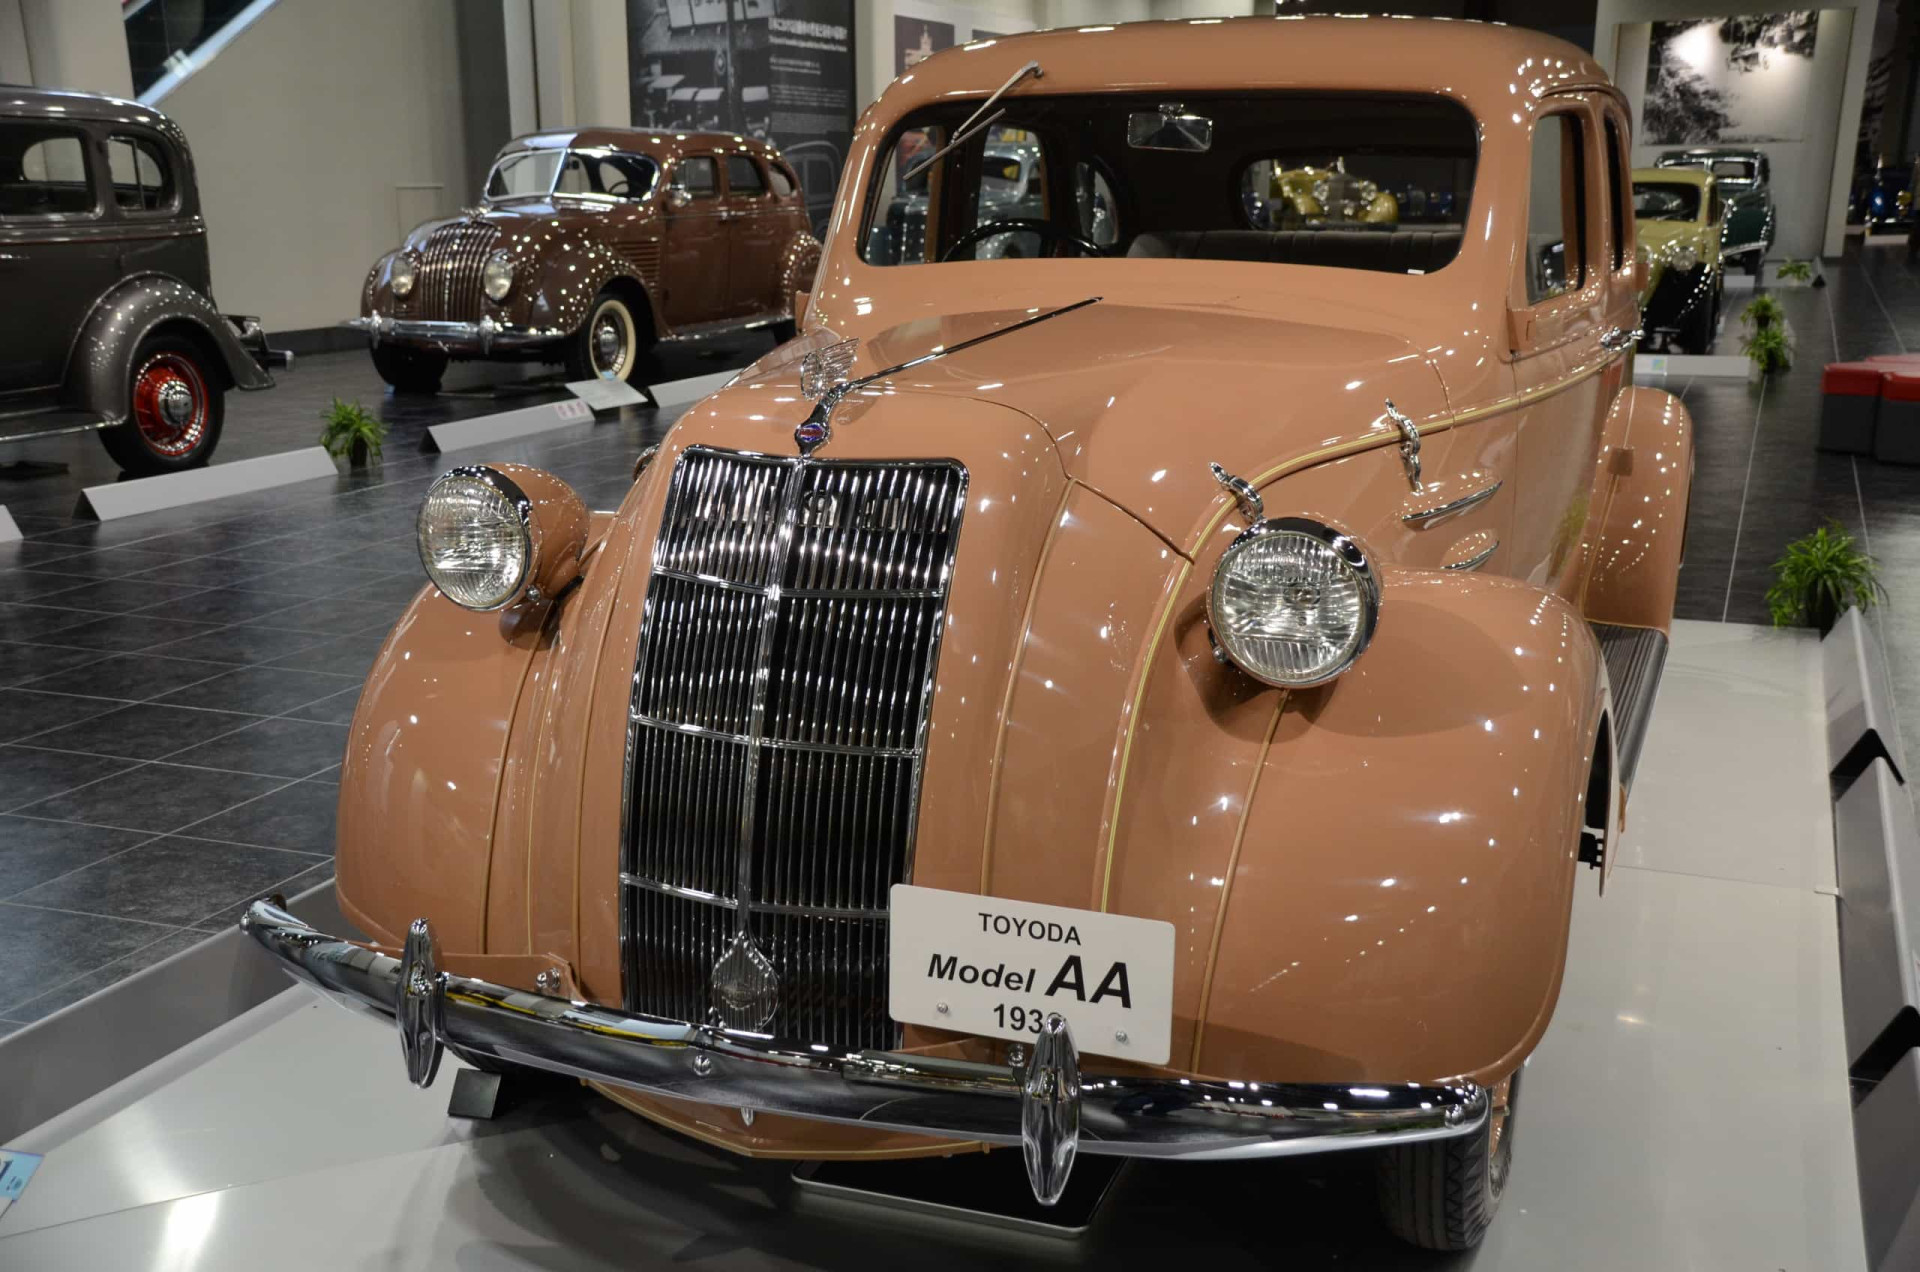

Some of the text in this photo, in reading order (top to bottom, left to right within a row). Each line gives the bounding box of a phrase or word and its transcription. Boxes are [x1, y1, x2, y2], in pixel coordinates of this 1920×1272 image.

[978, 912, 1082, 946] TOYODA
[927, 953, 1132, 1009] Model AA
[993, 1003, 1062, 1034] 193
